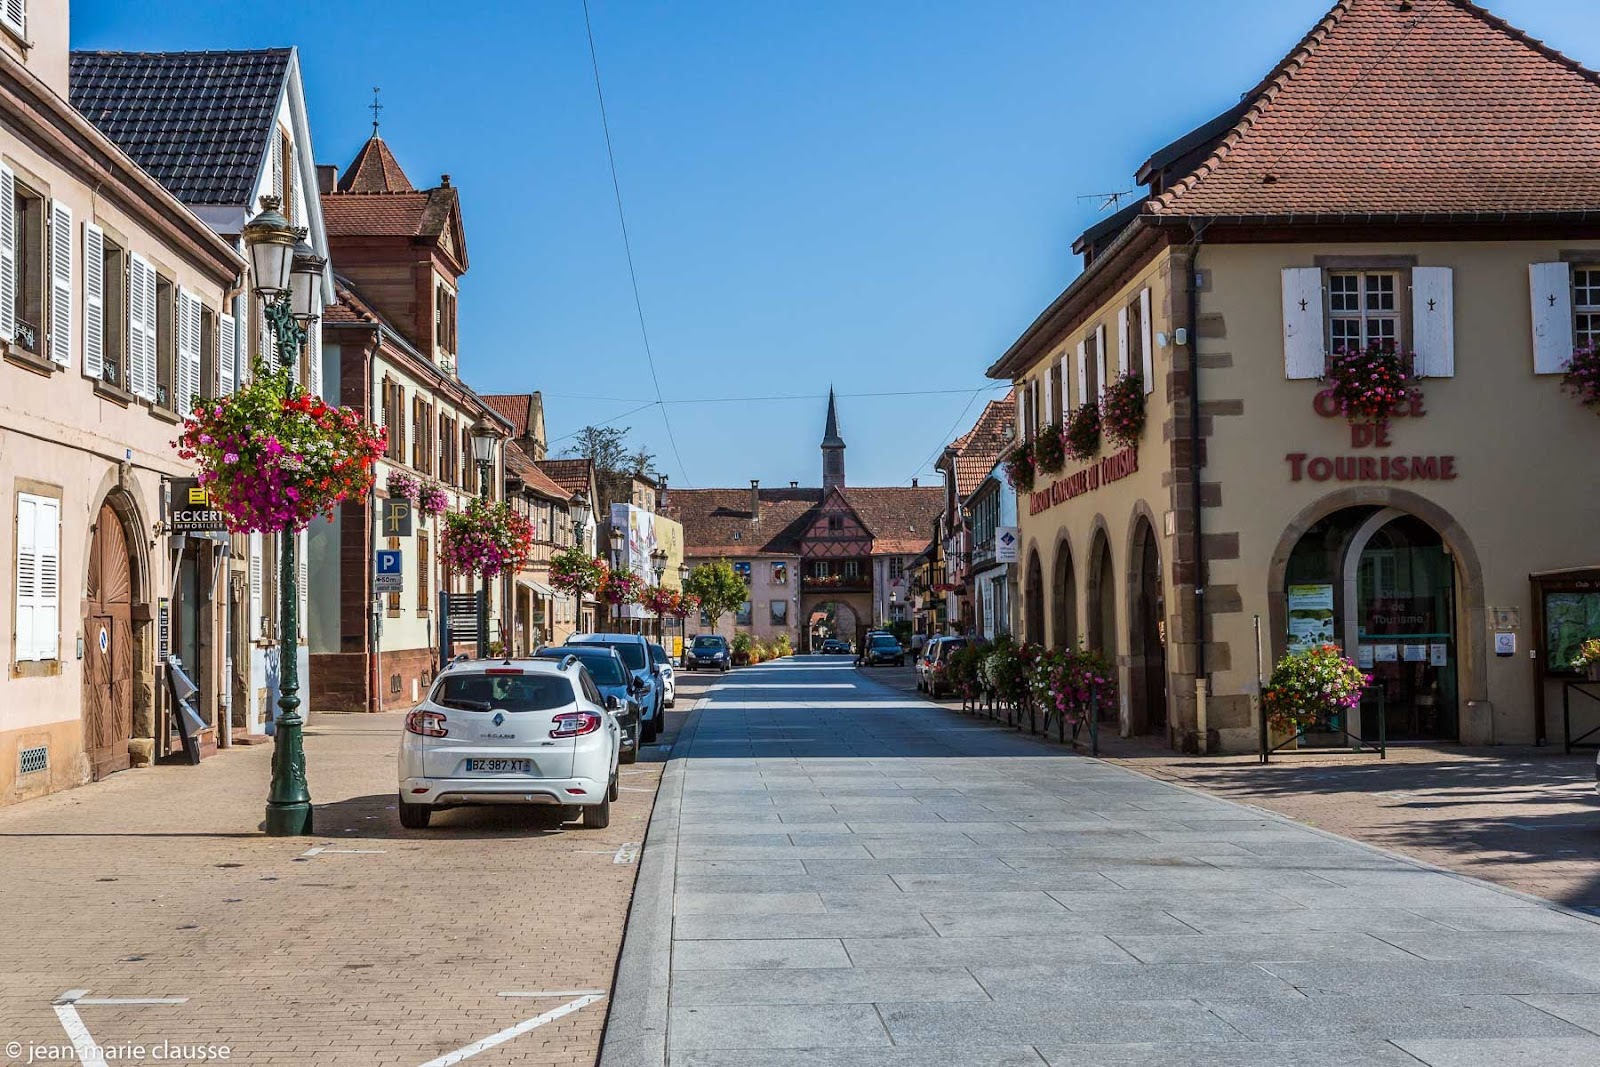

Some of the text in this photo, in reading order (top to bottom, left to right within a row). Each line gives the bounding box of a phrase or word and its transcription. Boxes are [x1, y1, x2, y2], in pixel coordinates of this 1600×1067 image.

[1351, 422, 1392, 448] DE
[1286, 453, 1458, 481] TOURISME
[1030, 488, 1051, 516] MAISON
[1087, 463, 1100, 491] DU
[1101, 446, 1139, 486] TOURISME
[173, 510, 223, 522] ECKERT
[383, 554, 395, 570] P
[1374, 614, 1424, 625] Tourisme
